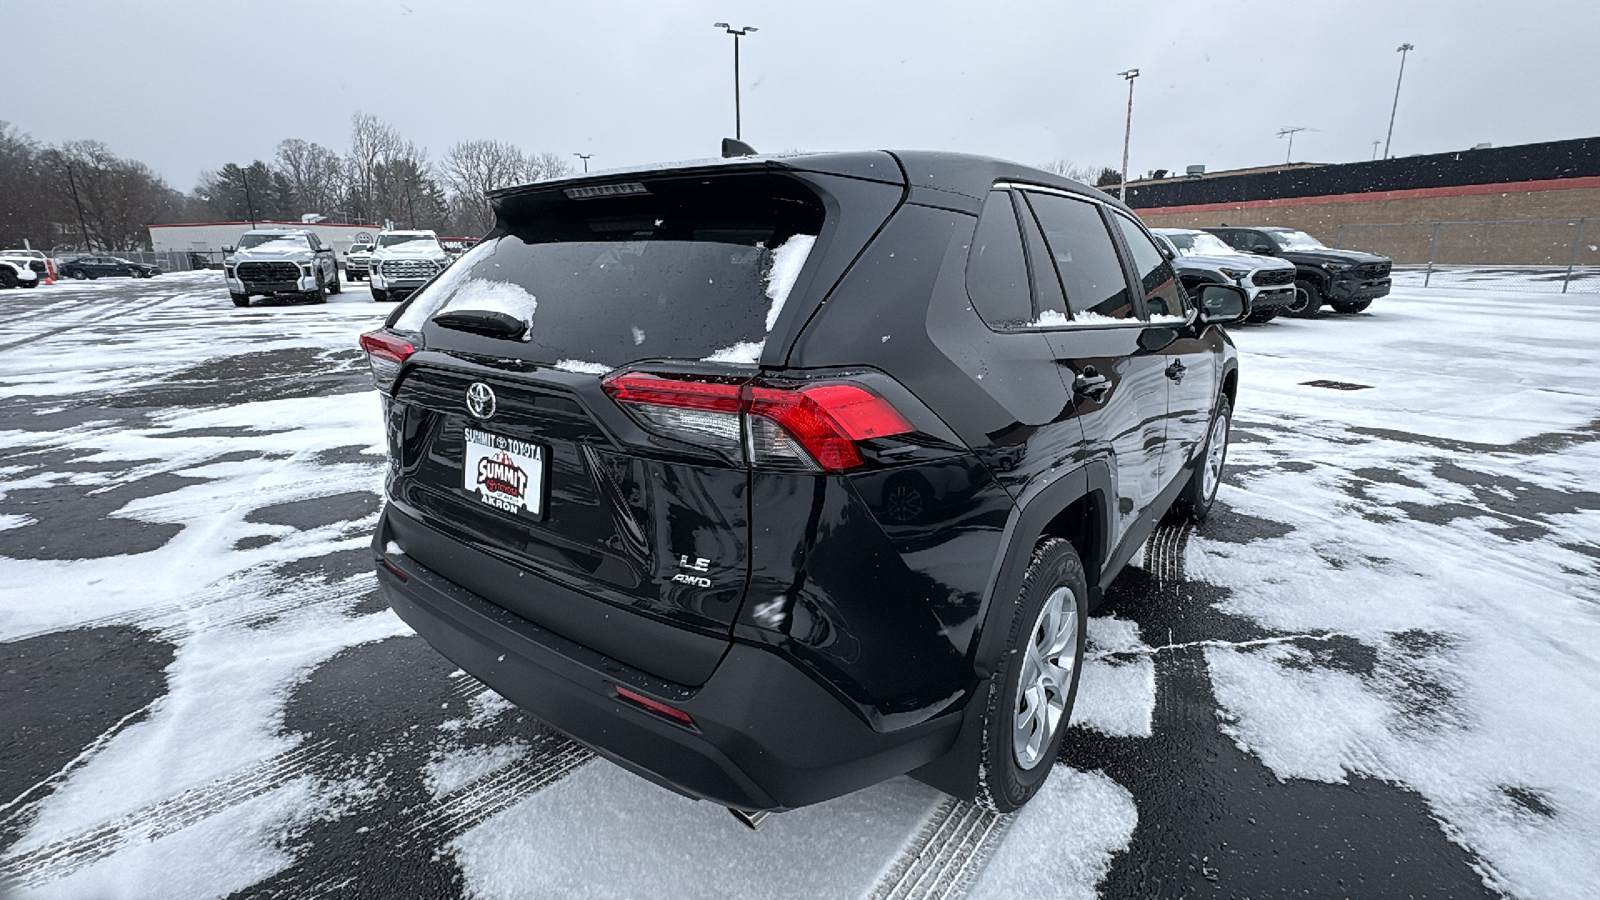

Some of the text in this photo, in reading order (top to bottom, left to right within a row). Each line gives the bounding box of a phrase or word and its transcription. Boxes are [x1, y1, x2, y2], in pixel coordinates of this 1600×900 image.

[465, 428, 541, 460] SUMMIT TOYOTA
[478, 459, 527, 496] SUMMIT
[497, 482, 518, 496] TOYOTA
[481, 495, 518, 514] AKRON
[680, 555, 710, 572] LE
[671, 574, 711, 587] AWD
